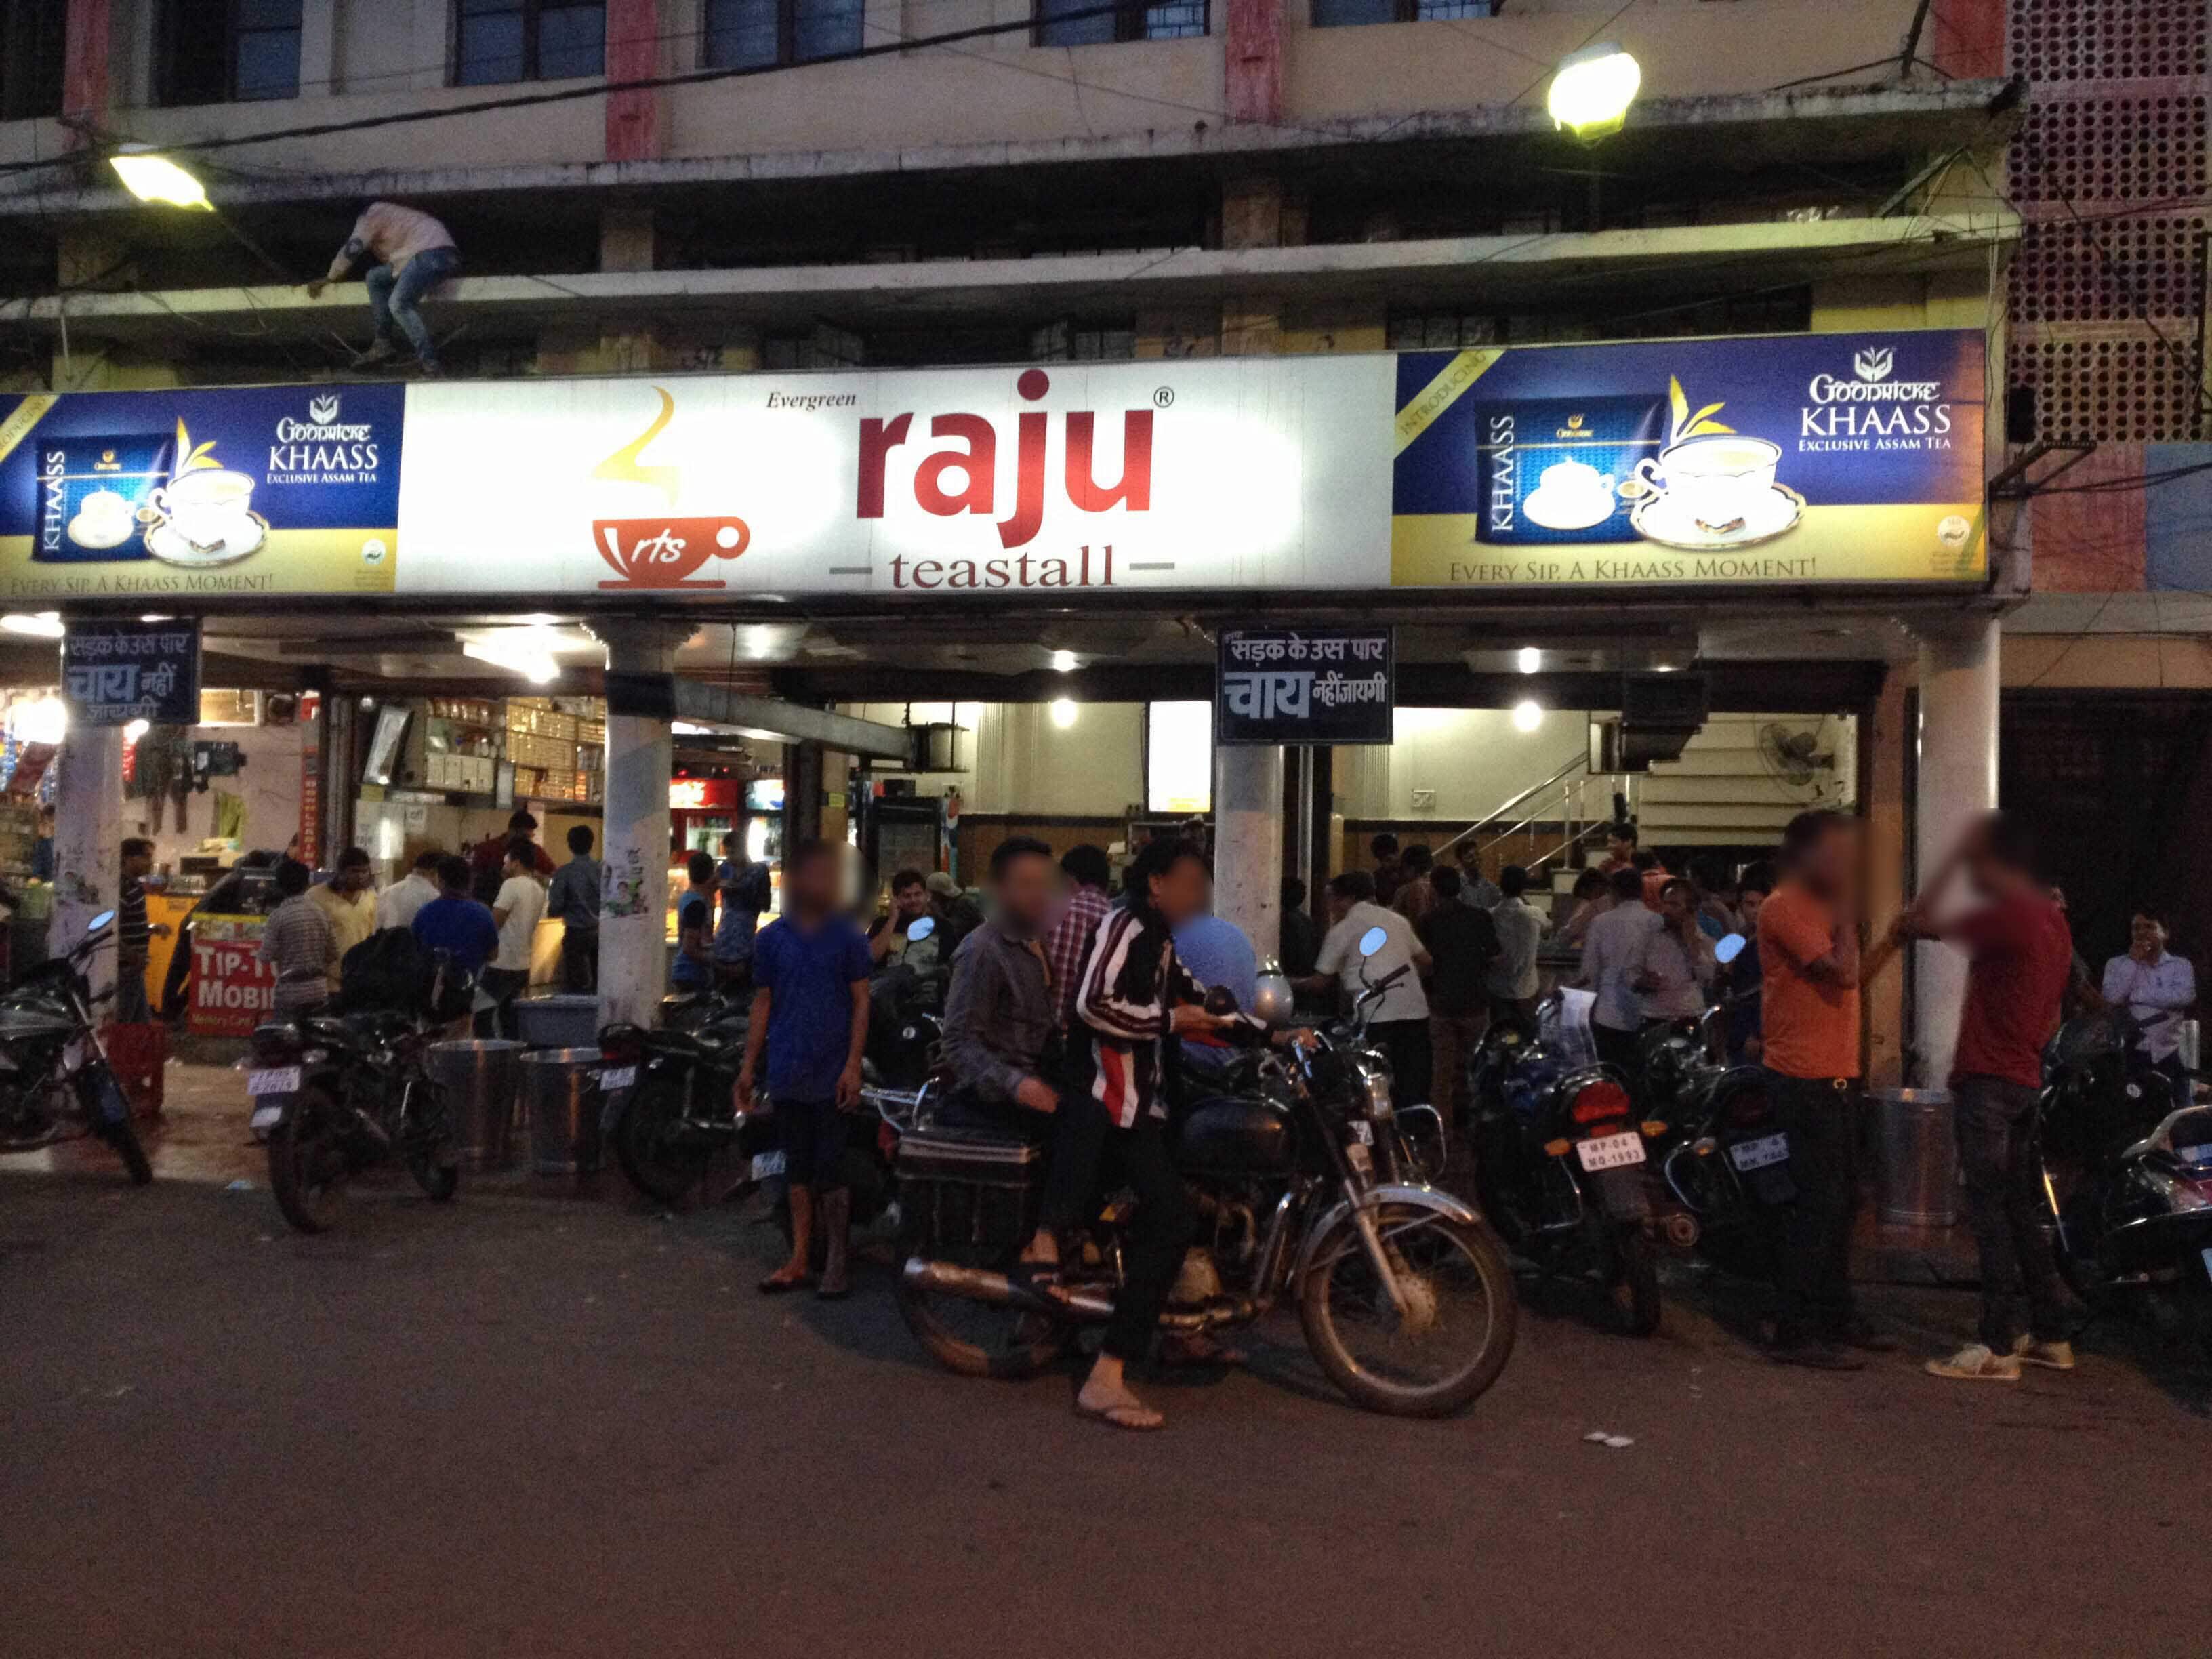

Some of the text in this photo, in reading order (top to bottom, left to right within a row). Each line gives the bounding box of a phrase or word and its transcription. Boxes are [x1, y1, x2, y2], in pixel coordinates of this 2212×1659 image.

[766, 391, 857, 413] Evergreen
[1400, 352, 1487, 436] INTRODUCING
[1801, 404, 1952, 436] KHAASS
[270, 444, 378, 471] KHAASS
[857, 369, 1154, 550] raju
[1799, 436, 1952, 452] EXCLUSIVE ASSAM TEA
[266, 472, 377, 485] EXCLUSIVE ASSAM TEA
[1491, 415, 1515, 531] KHAASS
[43, 451, 65, 550] KHAASS
[631, 528, 687, 564] rts
[10, 577, 60, 595] EVERY
[96, 576, 108, 592] A
[115, 575, 179, 592] KHAASS
[185, 573, 272, 591] MOMENT!
[888, 544, 1118, 589] teastall
[1449, 562, 1519, 581] EVERY
[1569, 561, 1584, 579] A
[1595, 560, 1685, 579] KHAASS
[1694, 556, 1816, 576] MOMENT!
[1231, 639, 1286, 668] सड़क
[1286, 631, 1309, 661] के
[1350, 638, 1387, 661] पार
[68, 664, 142, 703] चाय
[1224, 671, 1316, 720] चाय
[194, 946, 279, 978] TIP-T
